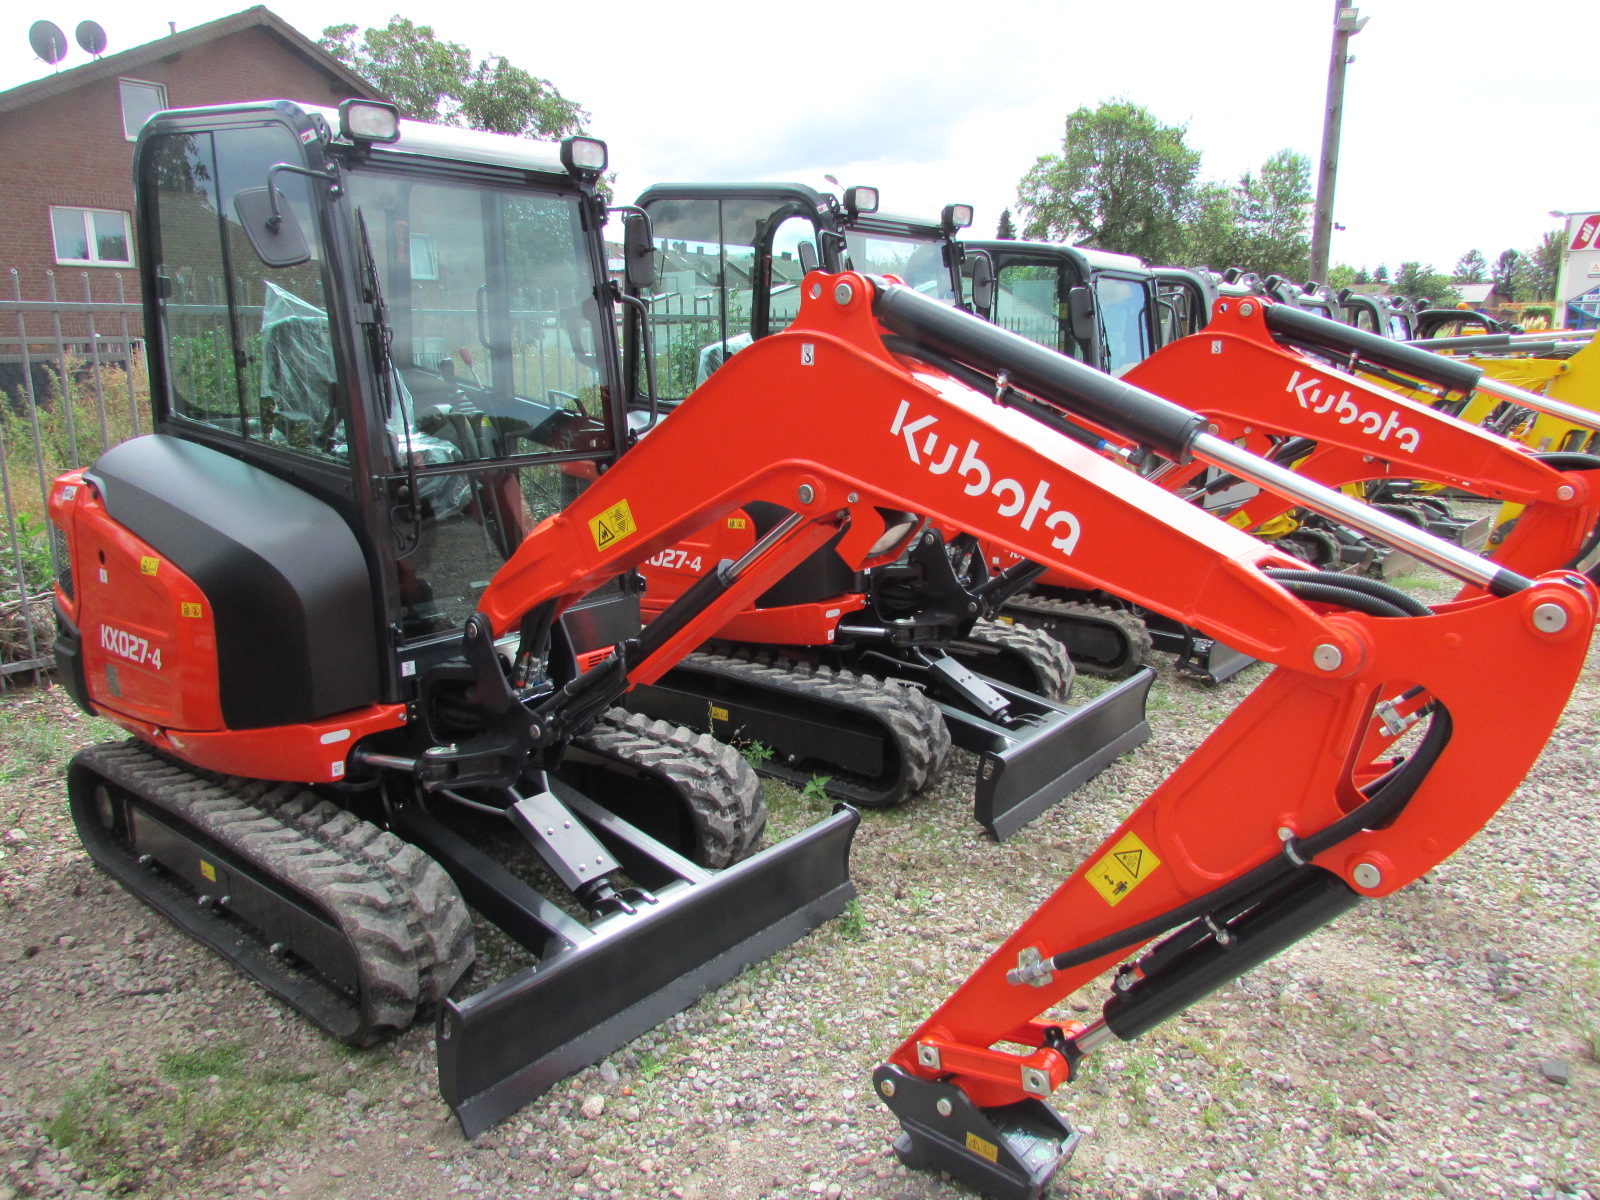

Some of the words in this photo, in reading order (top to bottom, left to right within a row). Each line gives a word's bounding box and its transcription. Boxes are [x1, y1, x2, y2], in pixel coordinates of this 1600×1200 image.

[1285, 370, 1420, 454] Kubota
[890, 399, 1081, 556] Kubota
[101, 623, 162, 670] KX027-4
